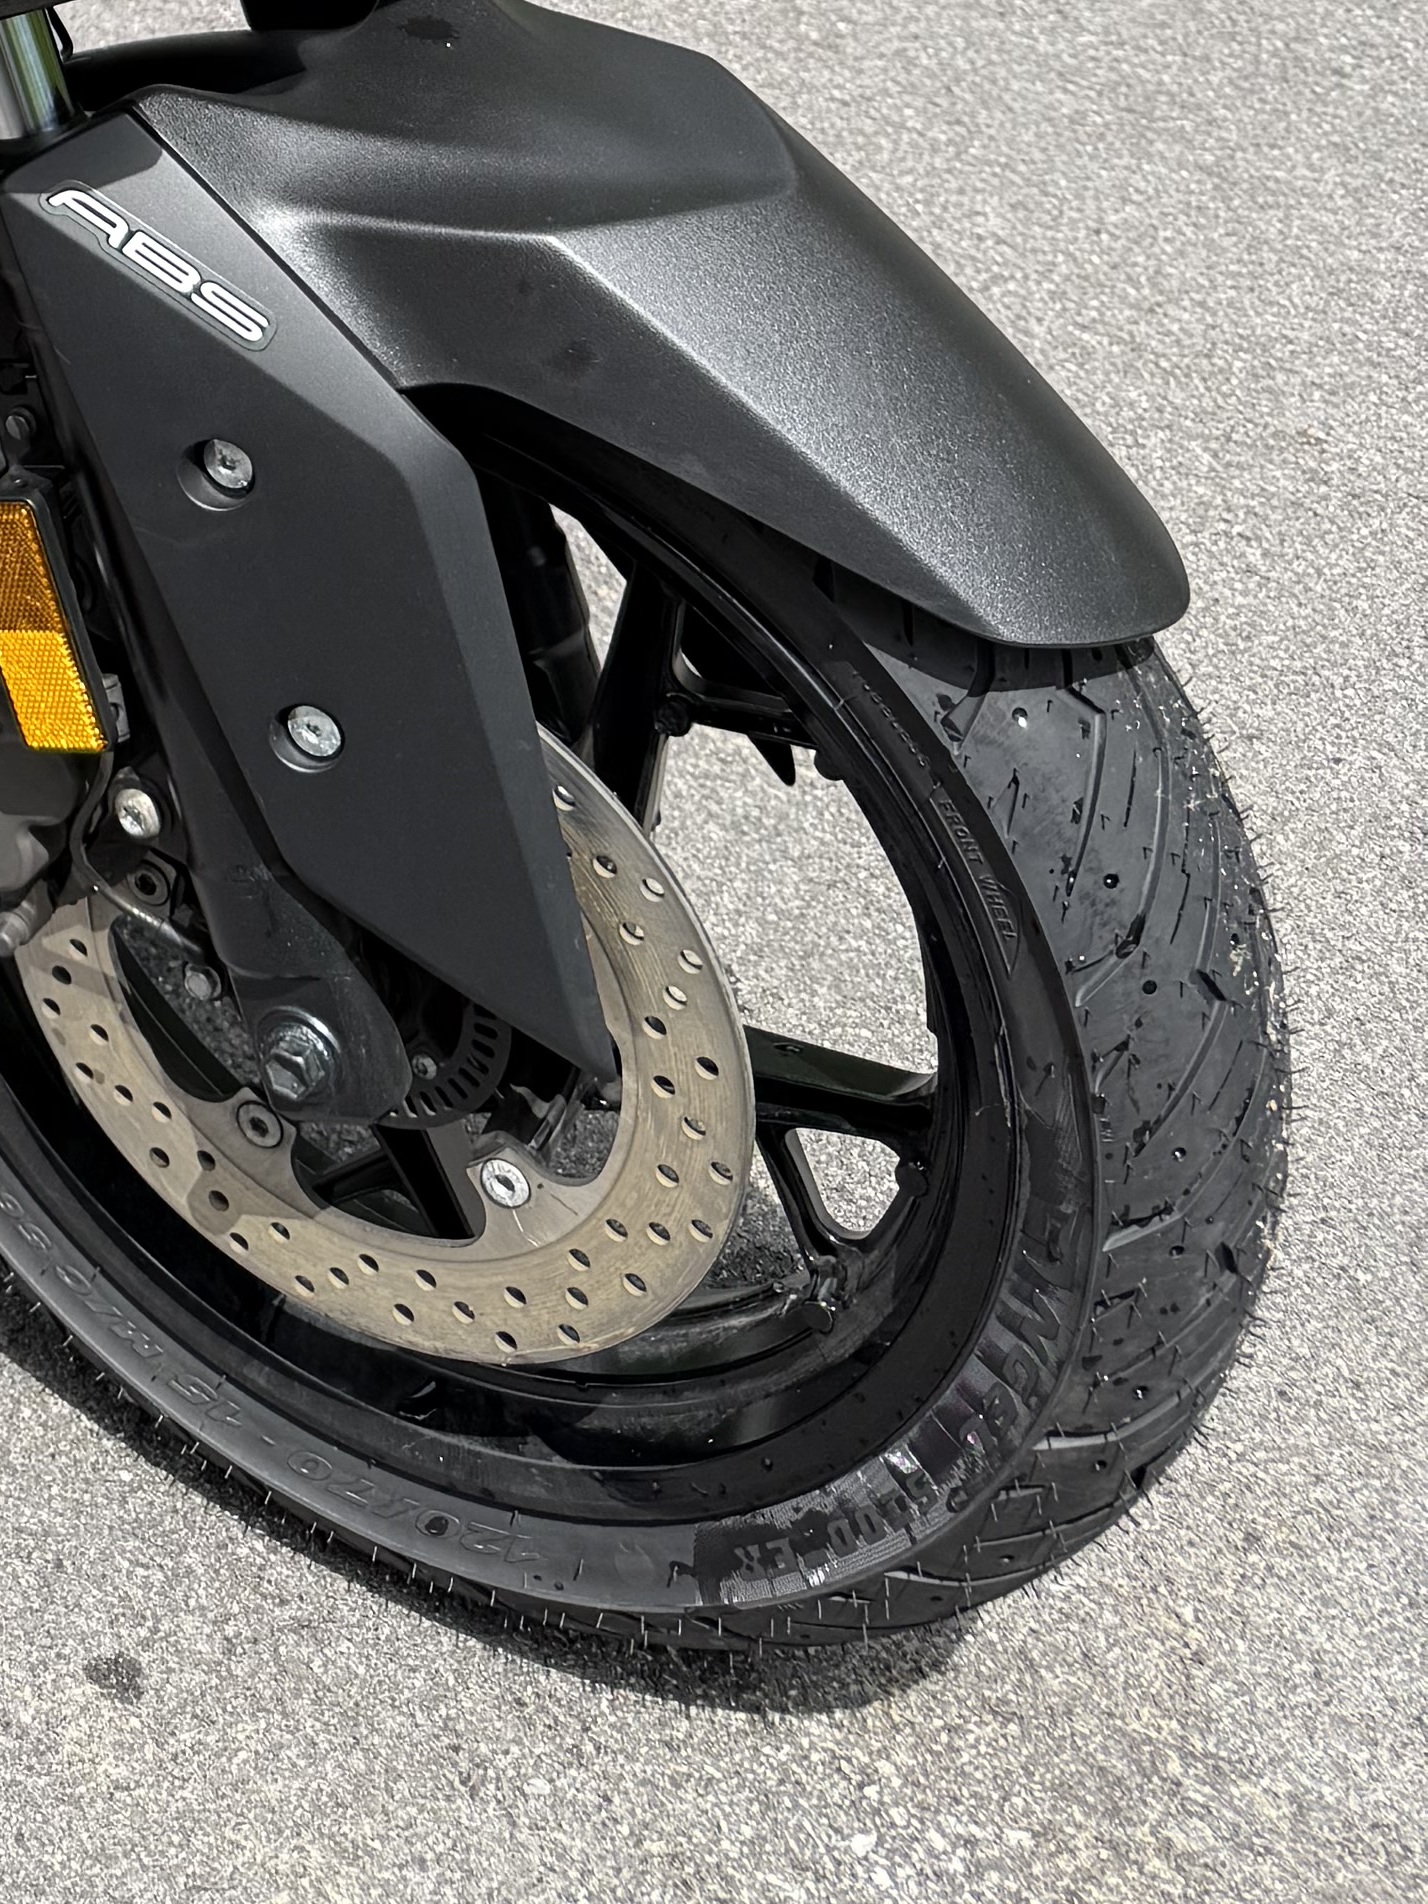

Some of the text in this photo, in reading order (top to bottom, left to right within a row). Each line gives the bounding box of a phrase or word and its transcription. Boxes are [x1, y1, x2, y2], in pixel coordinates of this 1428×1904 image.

[47, 190, 270, 342] ABS
[940, 798, 1018, 940] FRONT WHEEL
